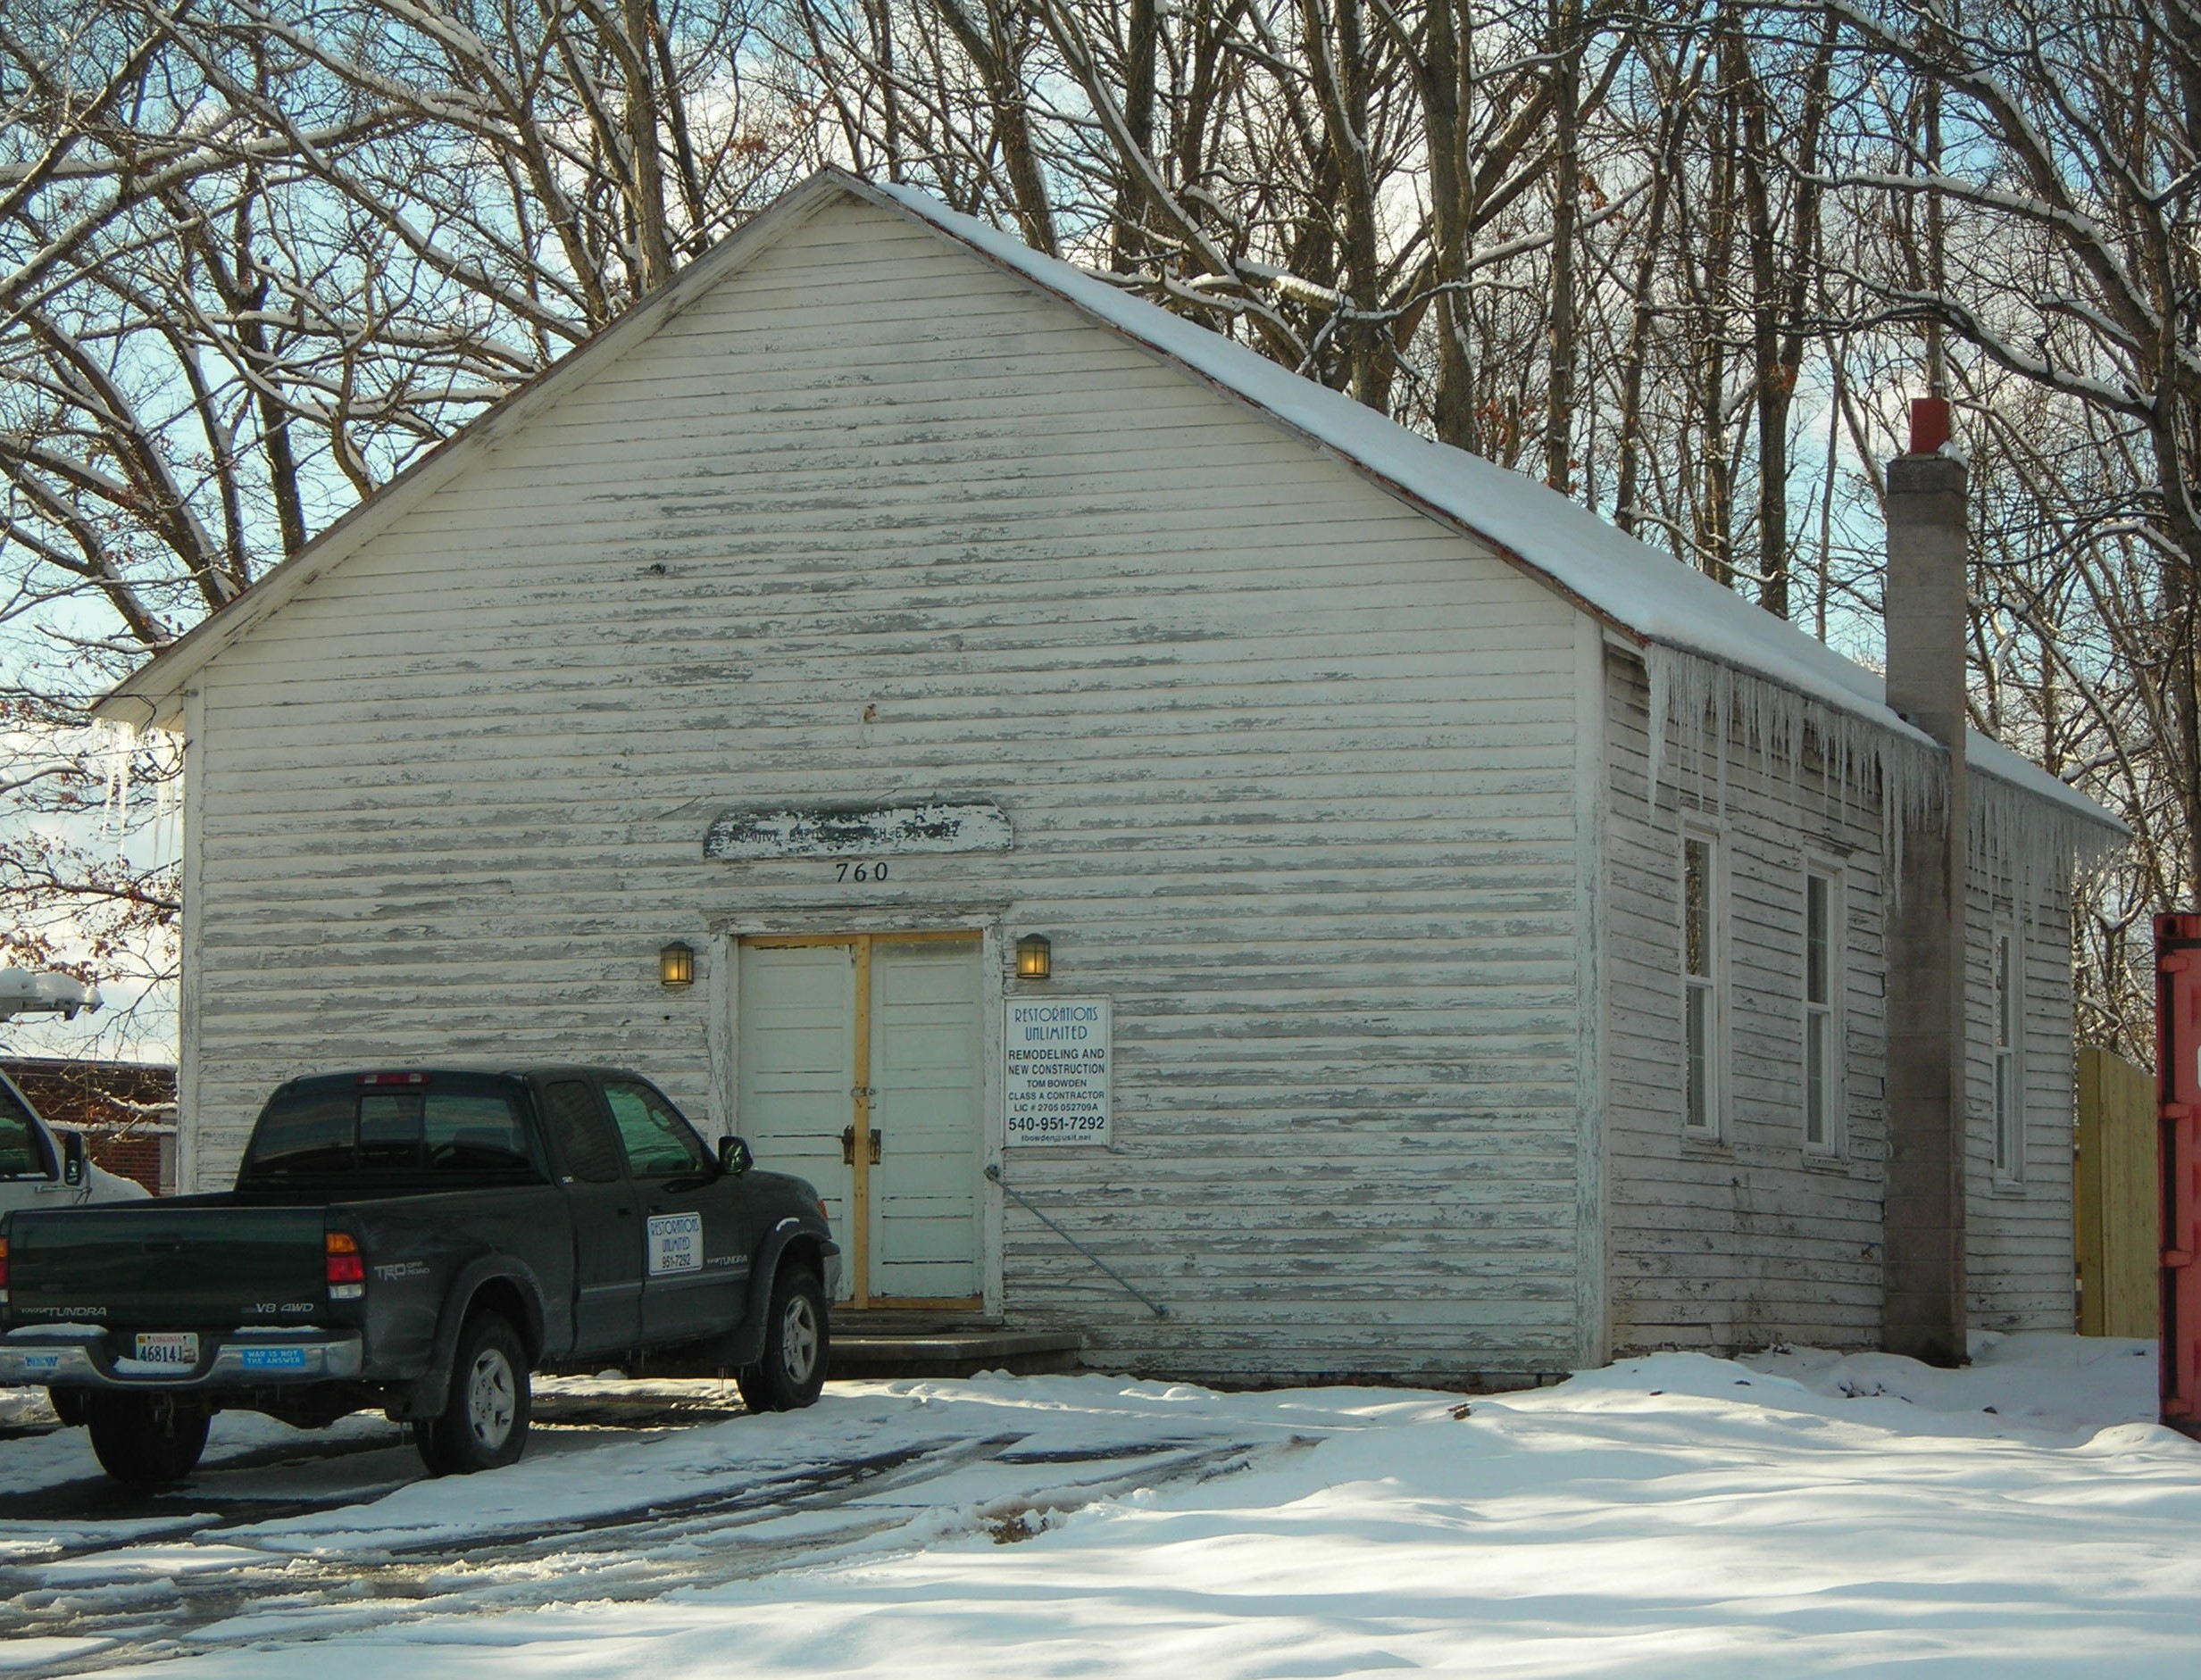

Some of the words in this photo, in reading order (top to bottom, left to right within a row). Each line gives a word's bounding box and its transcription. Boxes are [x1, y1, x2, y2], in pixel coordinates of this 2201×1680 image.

[836, 861, 888, 883] 760
[1014, 1006, 1098, 1022] RESTORATIONS
[1025, 1026, 1088, 1041] UNLIMITED
[1009, 1049, 1079, 1060] REMODELING
[1082, 1048, 1105, 1059] AND
[1009, 1065, 1030, 1076] NEW
[1031, 1063, 1105, 1075] CONSTRUCTION
[1027, 1079, 1046, 1088] TOM
[1047, 1078, 1087, 1087] BOWDEN
[1009, 1092, 1036, 1101] CLASS
[1038, 1092, 1045, 1100] A
[1046, 1091, 1105, 1100] CONTRACTOR
[1013, 1103, 1028, 1112] LIC
[1038, 1103, 1058, 1111] 2705
[1060, 1103, 1098, 1111] 052709A
[1008, 1116, 1105, 1131] 540-951-7292
[46, 1307, 107, 1316] TUNDRA
[255, 1302, 277, 1313] V8
[280, 1302, 314, 1312] 4WD
